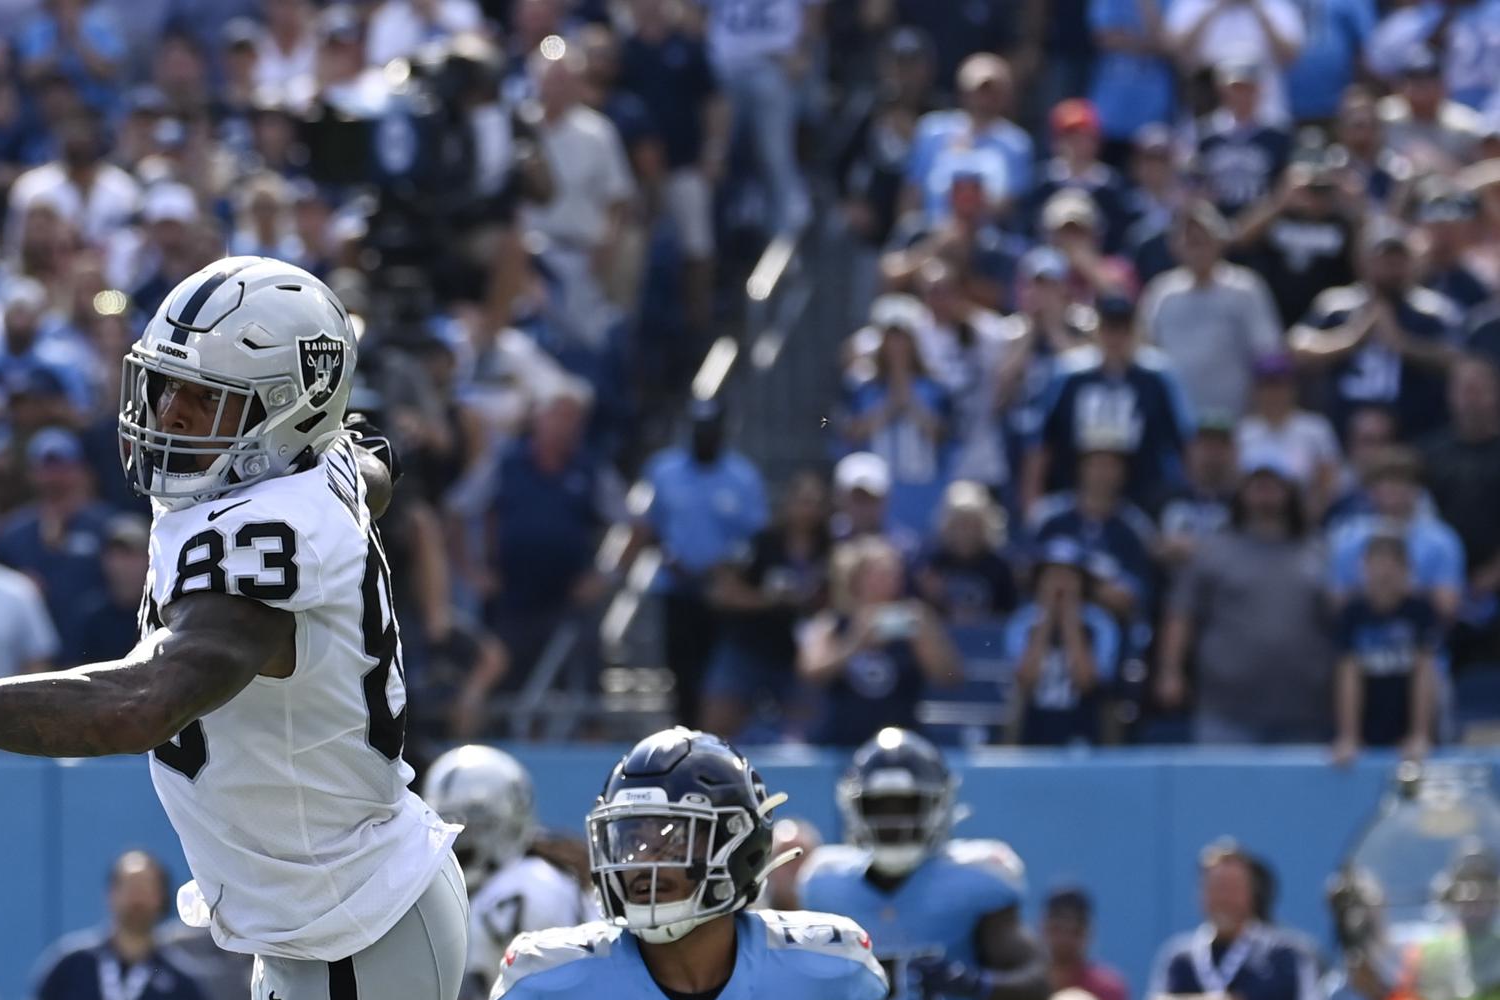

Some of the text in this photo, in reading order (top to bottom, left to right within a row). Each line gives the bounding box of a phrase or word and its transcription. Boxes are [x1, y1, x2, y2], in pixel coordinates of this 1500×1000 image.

[156, 343, 189, 360] RAIDERS
[304, 341, 342, 351] RAIDERS
[171, 519, 301, 600] 83
